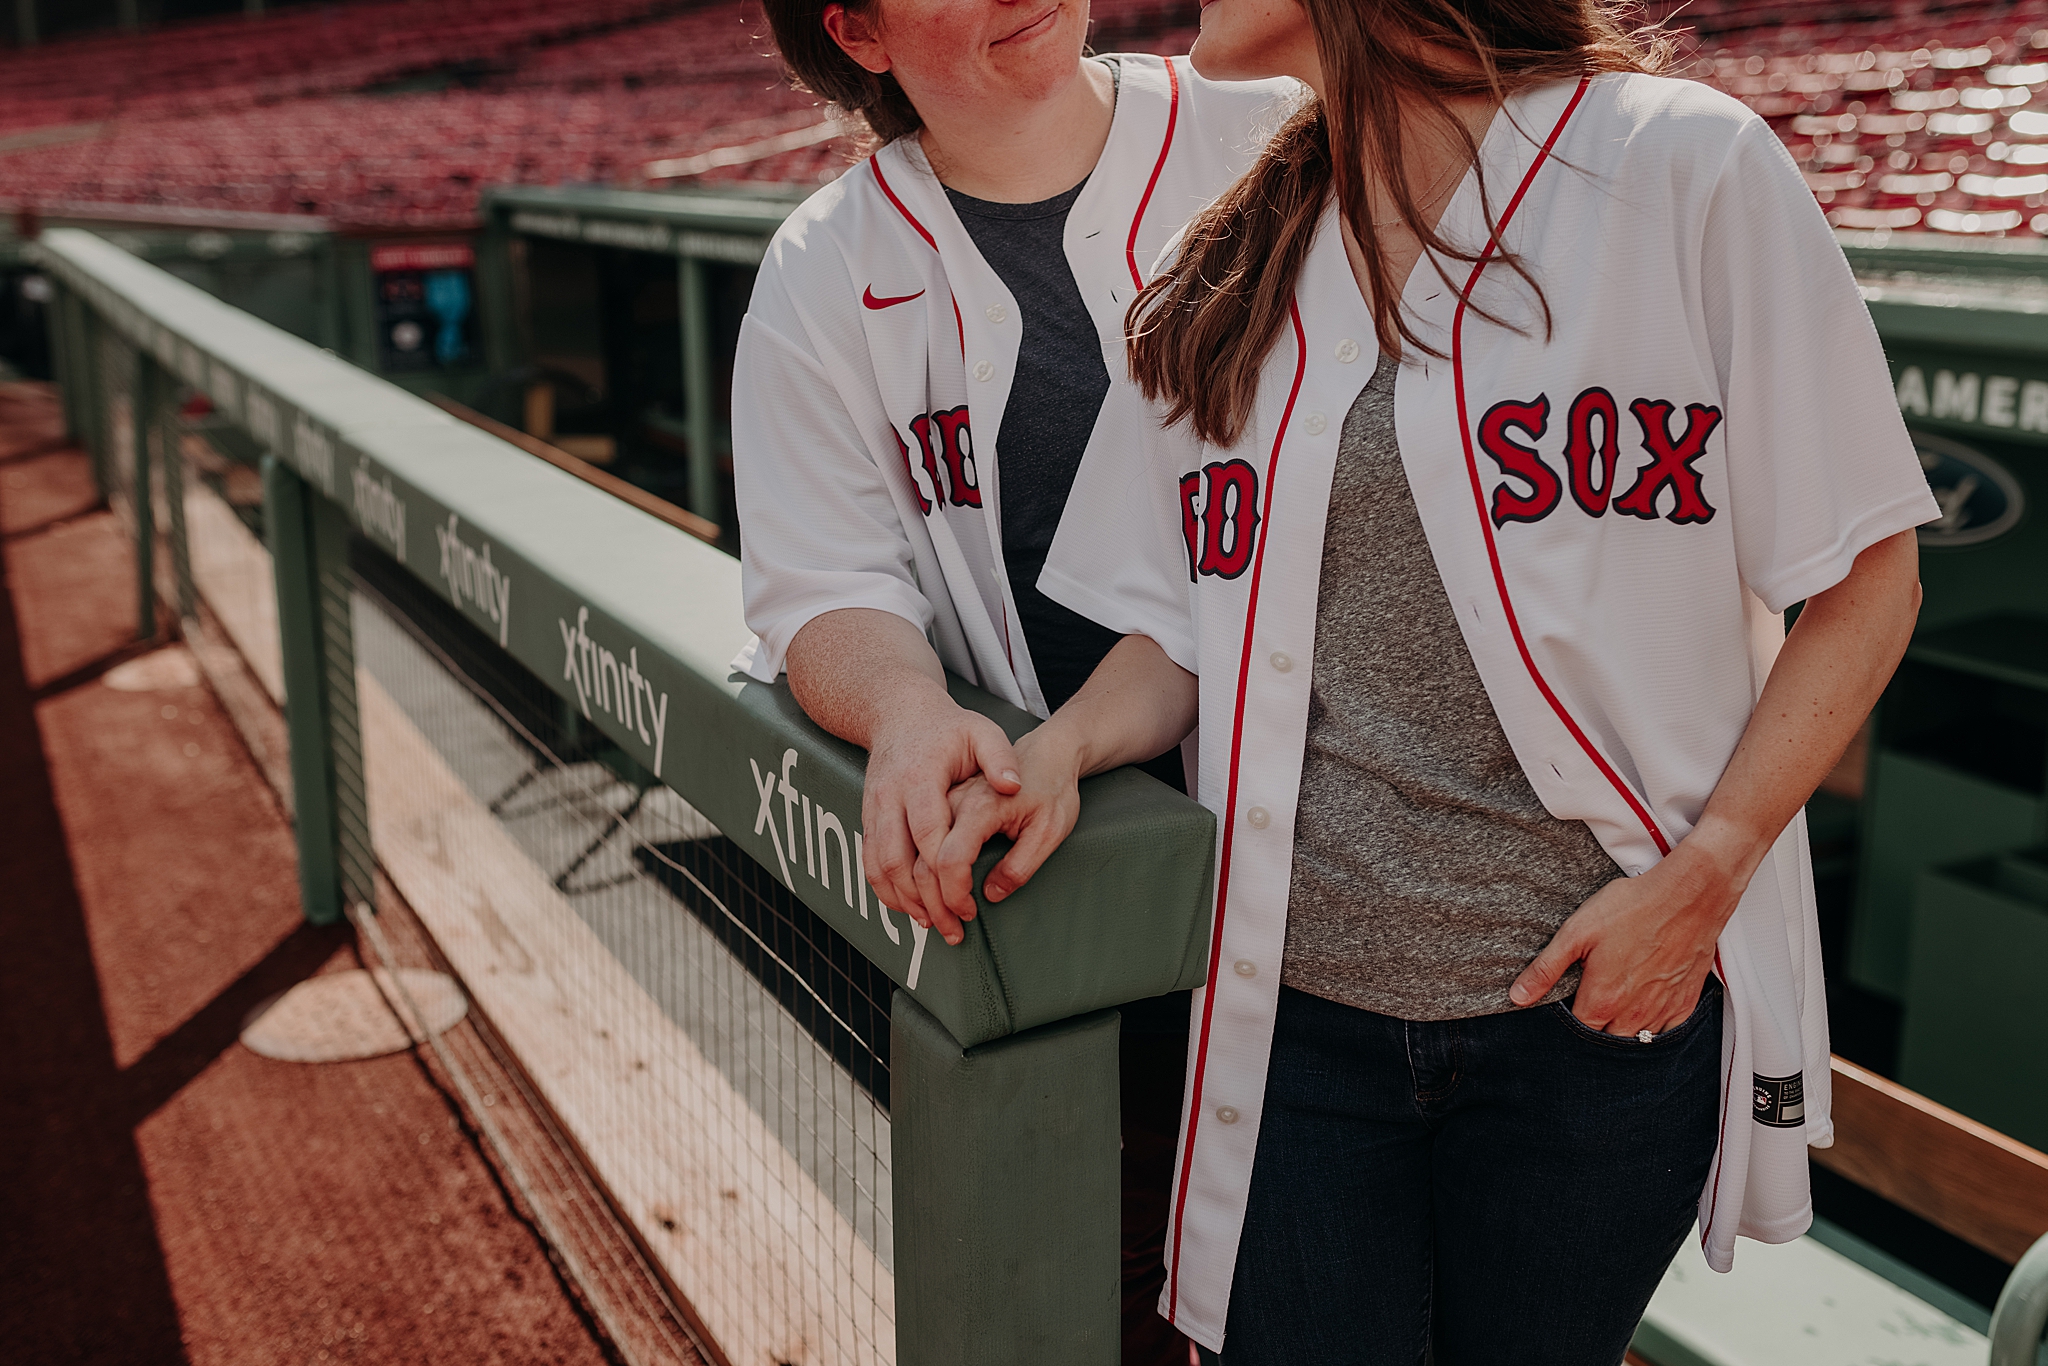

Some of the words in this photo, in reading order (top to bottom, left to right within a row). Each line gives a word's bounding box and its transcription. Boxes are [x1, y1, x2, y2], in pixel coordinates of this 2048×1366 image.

[1477, 386, 1723, 531] SOX
[436, 513, 510, 648] xfinity
[559, 606, 668, 778] xfinity
